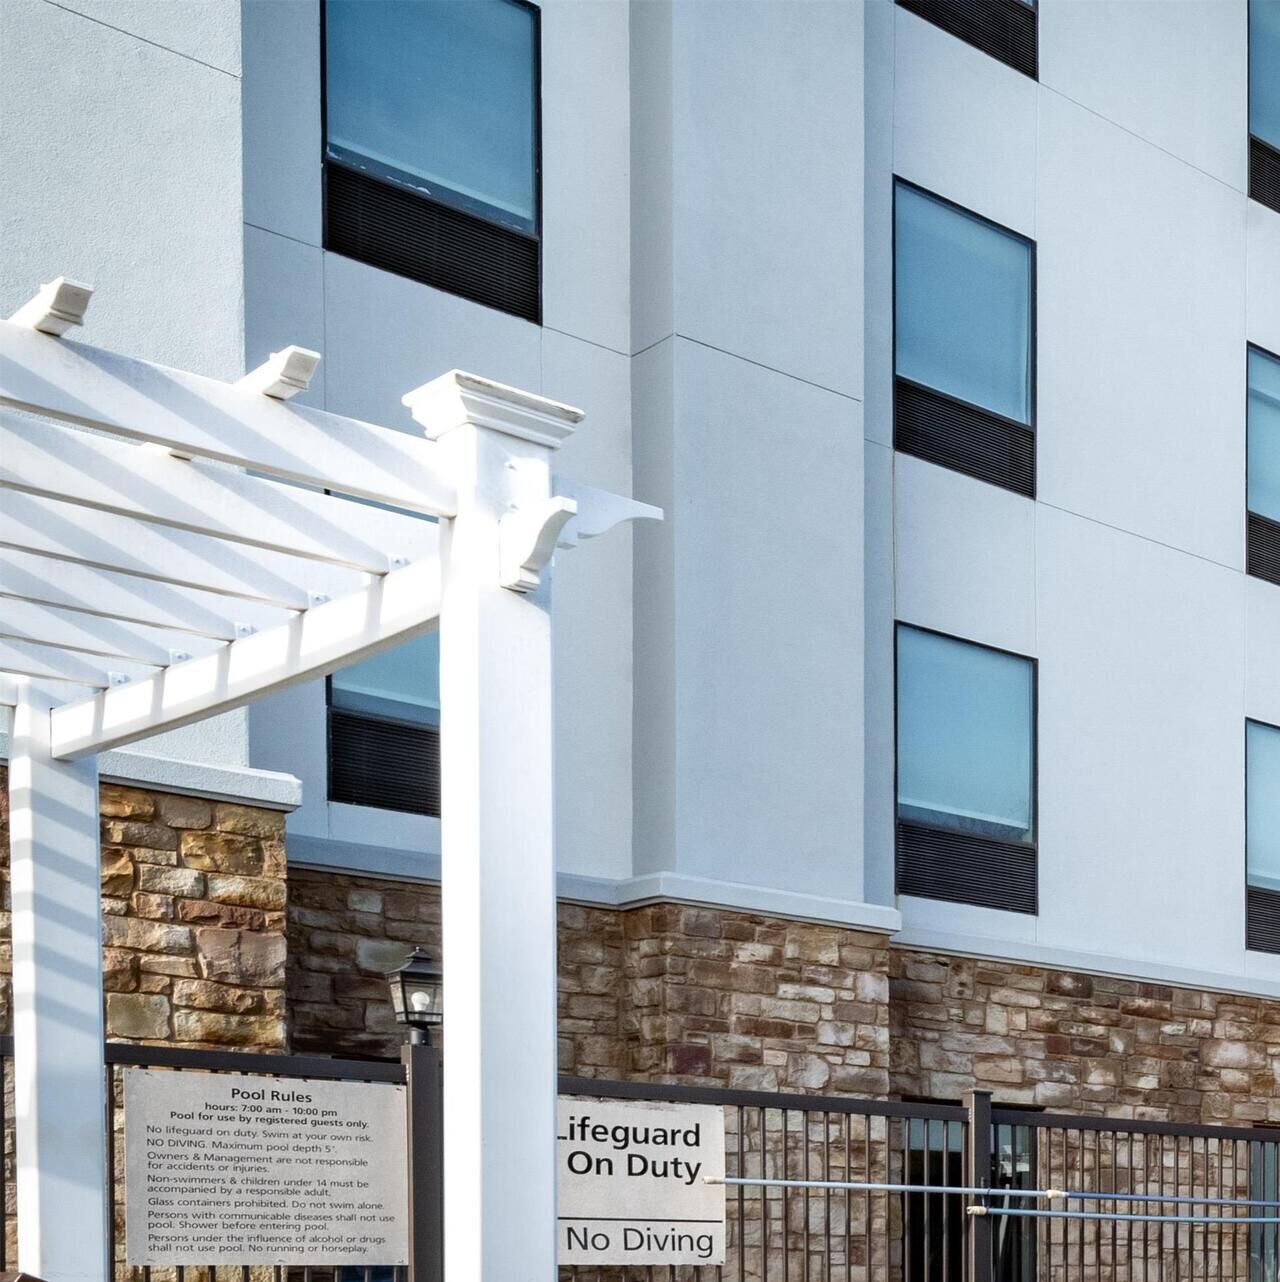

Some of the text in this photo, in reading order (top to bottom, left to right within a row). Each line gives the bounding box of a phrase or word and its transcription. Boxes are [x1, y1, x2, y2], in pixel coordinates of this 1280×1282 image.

[231, 1088, 312, 1103] Pool Rules
[204, 1102, 238, 1112] hours:
[241, 1104, 262, 1113] 7:00
[292, 1107, 318, 1116] 10:00
[321, 1109, 338, 1117] pm
[170, 1111, 194, 1120] Pool
[198, 1112, 214, 1120] for
[217, 1114, 236, 1122] use
[239, 1114, 252, 1124] by
[255, 1116, 307, 1126] registered
[310, 1118, 343, 1128] guests
[146, 1125, 162, 1134] No
[166, 1126, 213, 1136] lifeguard
[262, 1130, 289, 1139] Swim
[305, 1132, 327, 1141] your
[146, 1138, 164, 1147] NO
[211, 1141, 262, 1150] Maximum
[266, 1143, 289, 1152] pool
[292, 1144, 322, 1154] depth
[146, 1151, 189, 1160] Owners
[192, 1152, 200, 1160] &
[204, 1153, 272, 1164] Management
[295, 1157, 312, 1165] not
[315, 1158, 368, 1167] responsible
[147, 1160, 162, 1169] for
[166, 1162, 215, 1172] accidents
[567, 1151, 702, 1185] On Duty
[147, 1174, 369, 1188] Non-swimmers & children under 14 must be
[146, 1185, 216, 1194] accompanied
[220, 1186, 232, 1196] by
[245, 1187, 301, 1196] responsible
[147, 1197, 174, 1206] Glass
[177, 1198, 231, 1207] containers
[291, 1200, 306, 1208] Do
[309, 1201, 326, 1209] not
[329, 1201, 354, 1209] swim
[147, 1210, 188, 1219] Persons
[191, 1211, 216, 1220] with
[218, 1212, 291, 1220] communicable
[294, 1212, 333, 1221] diseases
[335, 1214, 357, 1222] shall
[360, 1214, 376, 1222] not
[178, 1220, 218, 1229] Shower
[222, 1221, 256, 1230] before
[259, 1222, 301, 1232] entering
[148, 1233, 189, 1242] Persons
[192, 1234, 222, 1242] under
[226, 1234, 244, 1242] the
[247, 1234, 292, 1243] influence
[295, 1234, 305, 1243] of
[309, 1235, 344, 1244] alcohol
[359, 1236, 386, 1245] drugs
[567, 1227, 713, 1258] No Diving
[148, 1243, 172, 1252] shall
[175, 1244, 194, 1252] not
[248, 1244, 263, 1252] No
[266, 1244, 304, 1254] running
